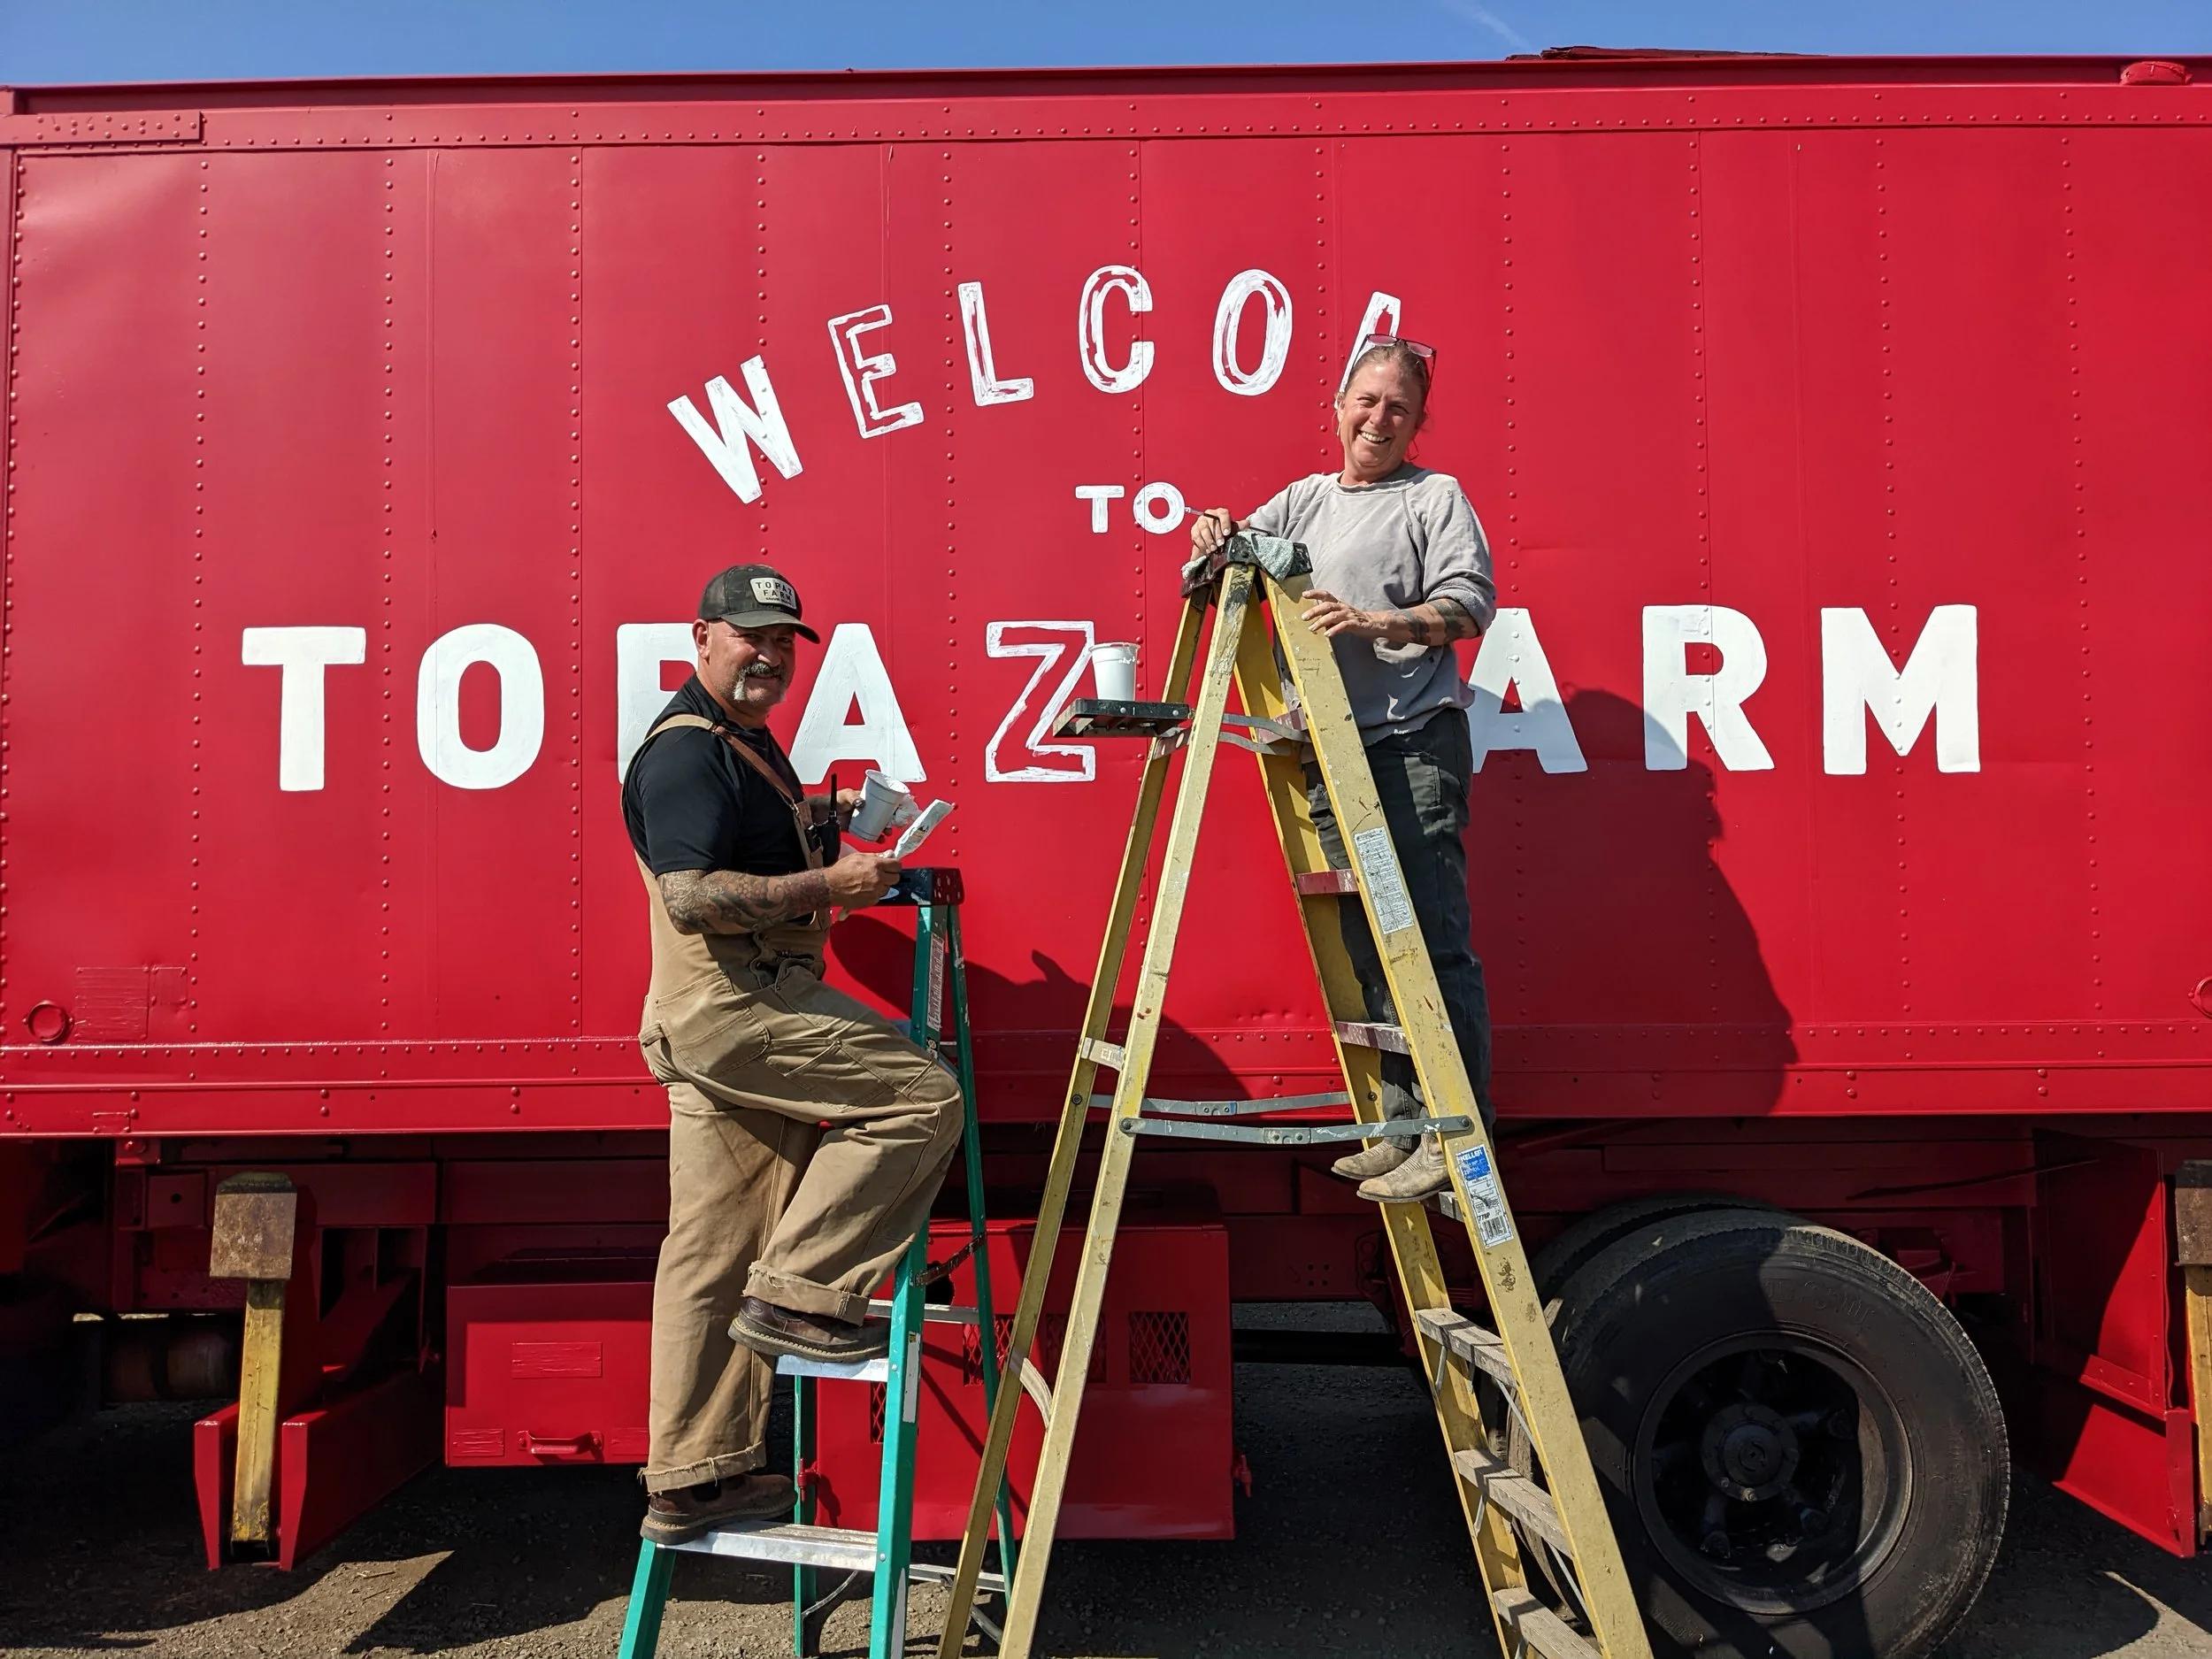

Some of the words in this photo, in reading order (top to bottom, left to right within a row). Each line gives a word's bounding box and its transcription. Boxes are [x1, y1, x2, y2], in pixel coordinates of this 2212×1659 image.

[1075, 481, 1185, 534] TO
[755, 581, 793, 596] TOPAZ
[763, 589, 791, 602] FARM
[242, 620, 1096, 791] TOPAZ
[1466, 604, 1981, 775] ARM
[1460, 1149, 1483, 1162] KELLER
